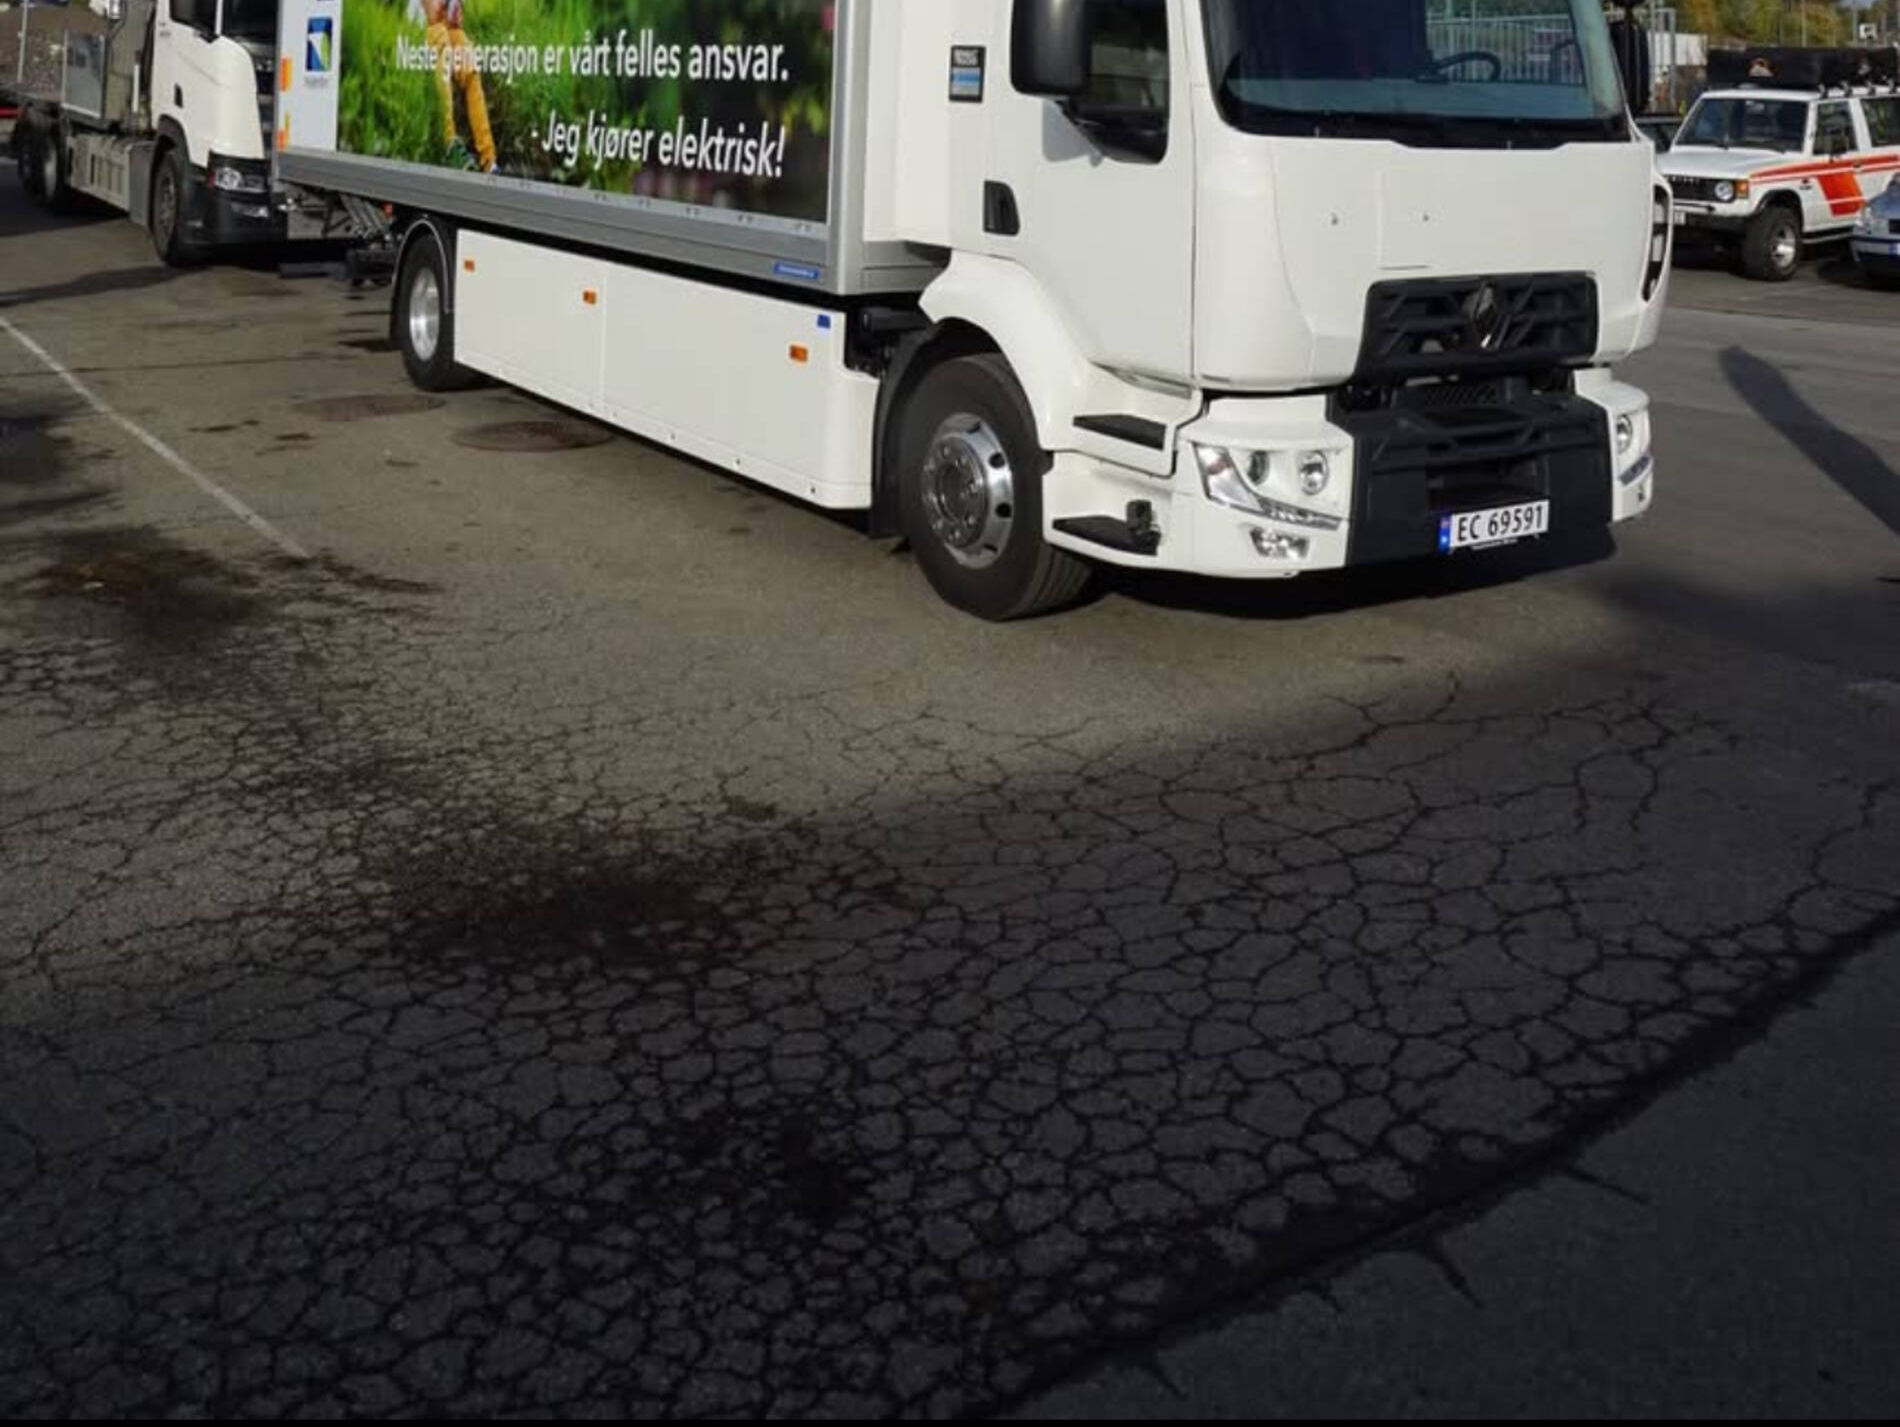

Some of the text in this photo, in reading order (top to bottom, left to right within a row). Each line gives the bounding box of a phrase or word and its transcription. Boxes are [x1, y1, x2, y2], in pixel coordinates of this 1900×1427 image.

[396, 28, 790, 85] Neste generasjon er vårt felles ansvar.
[541, 108, 580, 168] Jeg
[585, 109, 655, 171] kjører
[658, 115, 786, 178] elektrisk!
[1457, 504, 1544, 542] EC 69591
